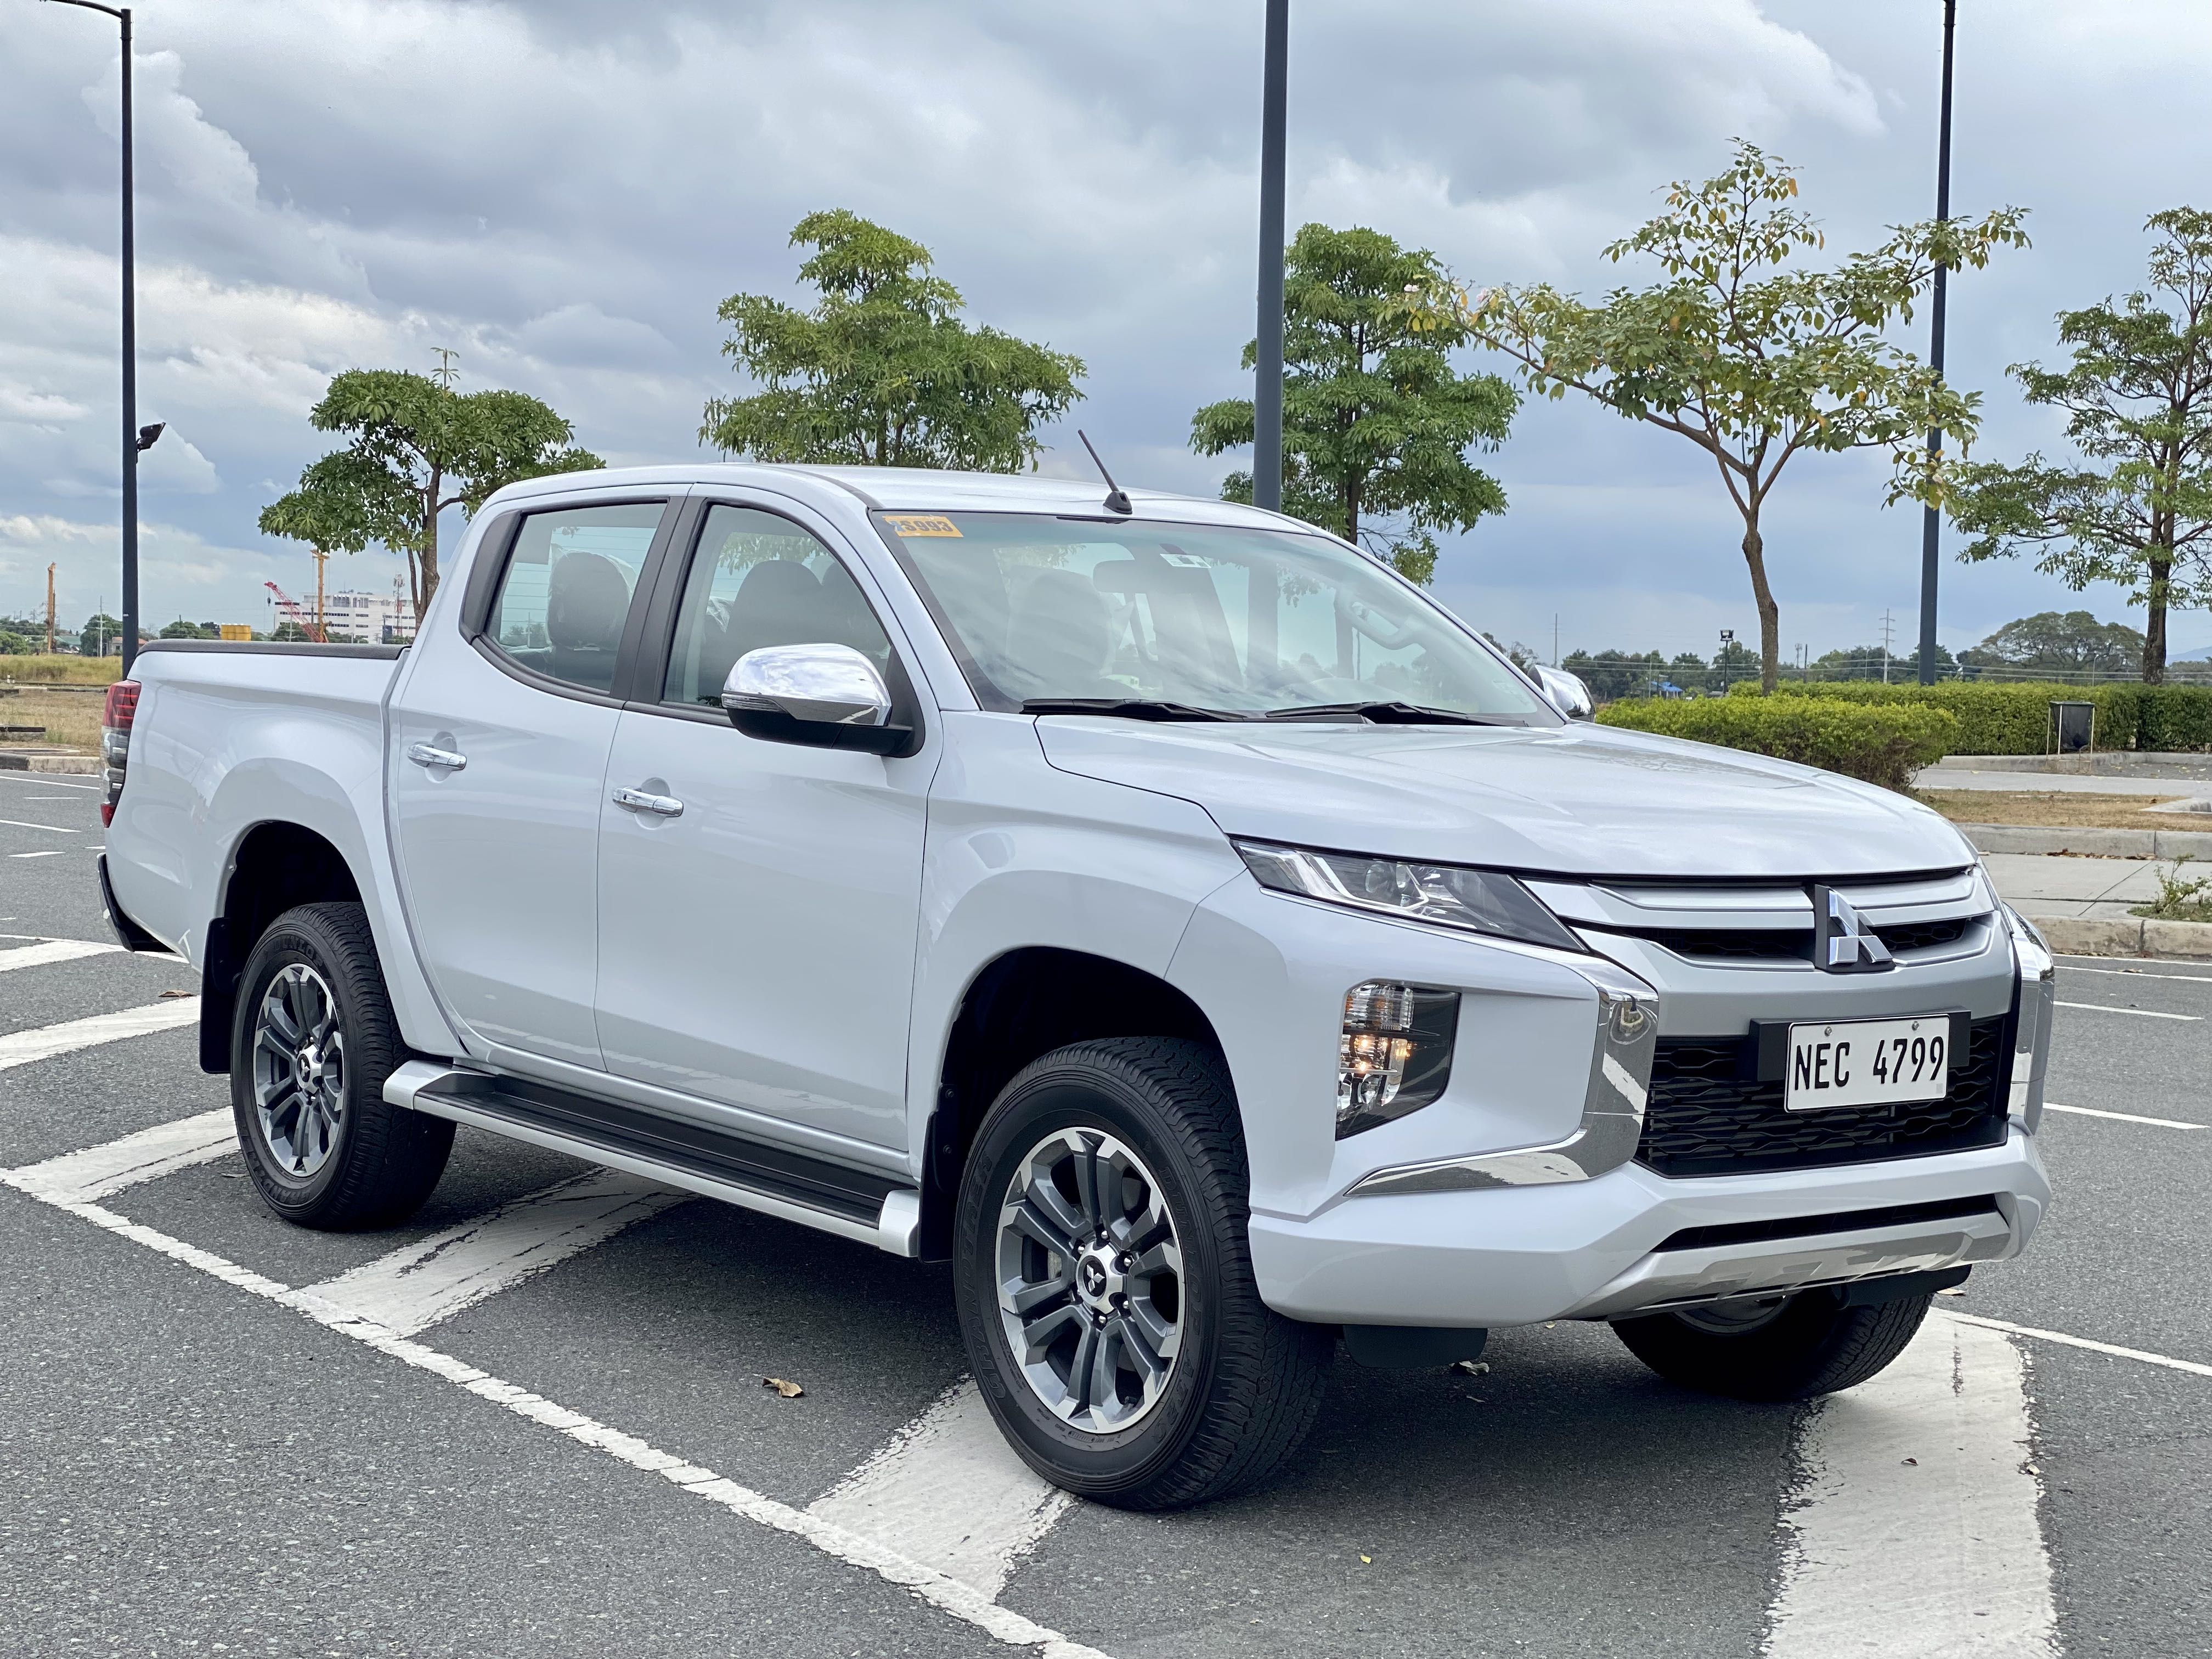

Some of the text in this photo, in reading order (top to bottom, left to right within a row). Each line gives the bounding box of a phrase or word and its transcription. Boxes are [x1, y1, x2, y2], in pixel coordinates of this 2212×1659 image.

[273, 936, 323, 968] DUNLOP
[1795, 1036, 1944, 1091] NEC 4799
[961, 1152, 1006, 1398] GRANDTREK
[1158, 1166, 1201, 1336] DUNLOP
